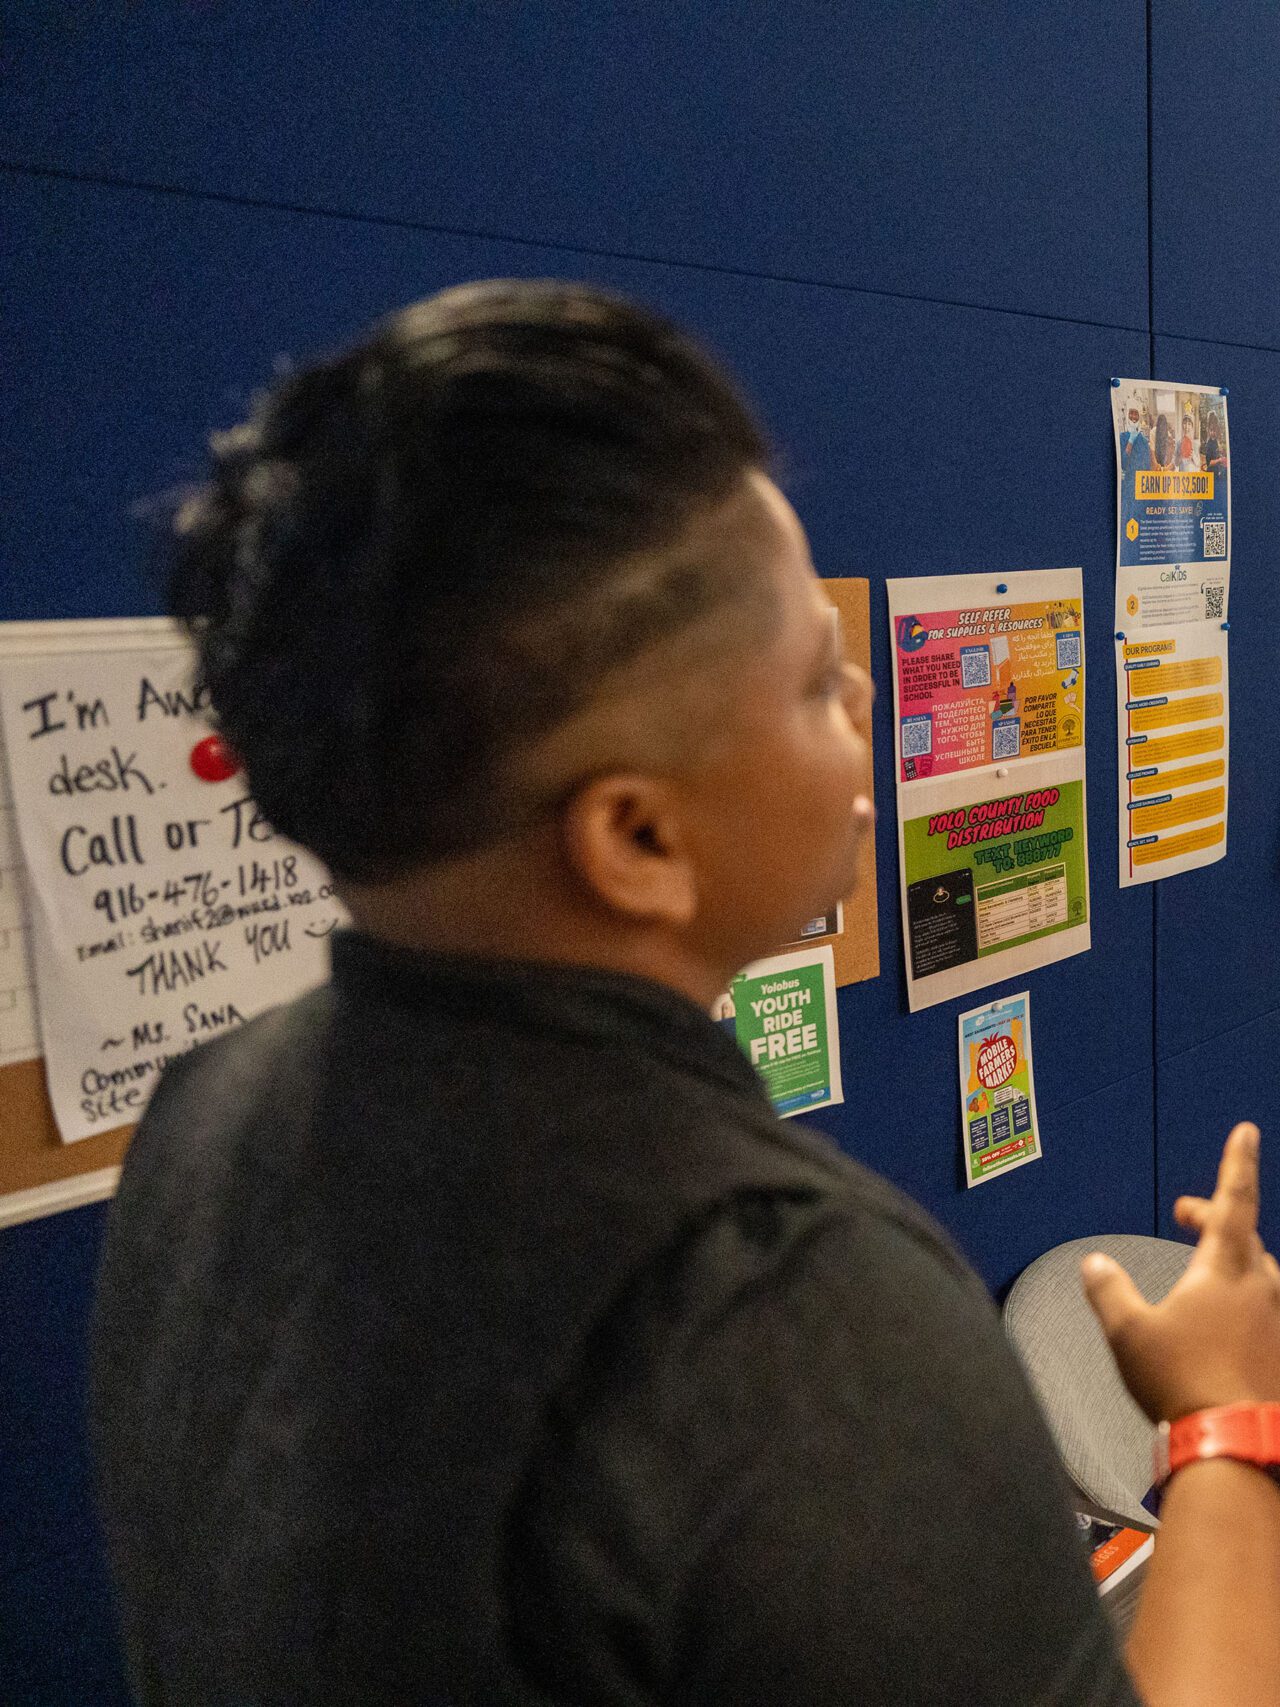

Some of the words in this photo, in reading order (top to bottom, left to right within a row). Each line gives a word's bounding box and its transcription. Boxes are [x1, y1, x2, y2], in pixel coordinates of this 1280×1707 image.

[1141, 475, 1160, 494] EARN
[1162, 475, 1171, 494] UP
[1173, 476, 1181, 494] TO
[1182, 476, 1209, 495] $2,500!
[1130, 524, 1135, 534] 1
[1160, 570, 1188, 583] CalKIDS
[1130, 600, 1135, 610] 2
[958, 611, 981, 625] SELF
[983, 608, 1011, 622] REFER
[927, 628, 945, 640] FOR
[946, 624, 986, 639] SUPPLIES
[989, 622, 996, 634] &
[997, 617, 1044, 632] RESOURCES
[1125, 645, 1140, 656] OUR
[1140, 642, 1173, 655] PROGRAMS
[902, 656, 929, 666] PLEASE
[931, 652, 955, 662] SHARE
[902, 667, 924, 676] WHAT
[926, 663, 941, 672] YOU
[942, 661, 961, 670] NEED
[903, 676, 911, 685] IN
[912, 672, 937, 683] ORDER
[939, 670, 948, 679] TO
[949, 669, 959, 678] BE
[903, 681, 951, 693] SUCCESSFUL
[952, 678, 960, 686] IN
[903, 691, 934, 702] SCHOOL
[1024, 696, 1037, 704] POR
[1037, 693, 1057, 702] FAVOR
[937, 706, 986, 720] ПОДЕЛИТЕСЬ
[1024, 701, 1056, 712] COMPARTE
[1036, 711, 1044, 719] LO
[1044, 708, 1057, 717] QUE
[23, 690, 109, 741] I'm
[953, 716, 968, 724] ЧТО
[970, 713, 986, 722] ВАМ
[1024, 717, 1057, 729] NECESITAS
[941, 725, 969, 735] НУЖНО
[970, 721, 985, 730] ДЛЯ
[960, 729, 985, 740] ЧТОБЫ
[1021, 729, 1038, 738] PARA
[1038, 725, 1057, 735] TENER
[966, 738, 985, 748] БЫТЬ
[1040, 734, 1049, 742] EN
[1049, 732, 1057, 740] LA
[1030, 740, 1057, 752] ESCUELA
[935, 747, 980, 761] УСПЕШНЫМ
[958, 754, 985, 765] ШКОЛЕ
[49, 745, 168, 797] desk.
[928, 809, 965, 836] YOLO
[968, 795, 1024, 824] COUNTY
[1024, 788, 1060, 811] FOOD
[60, 814, 146, 876] Call
[165, 816, 209, 852] or
[220, 796, 274, 850] Te
[947, 809, 1045, 850] DISTRIBUTION
[974, 843, 1011, 865] TEXT
[1013, 827, 1074, 855] KEYWORD
[93, 855, 299, 926] 916-476-1418
[126, 938, 229, 997] THANK
[244, 918, 293, 965] YOU
[760, 979, 800, 995] Yolobus
[750, 988, 811, 1017] YOUTH
[763, 1009, 803, 1034] RIDE
[750, 1023, 818, 1066] FREE
[980, 1038, 1009, 1067] MOBILE
[978, 1044, 1016, 1080] FARMERS
[985, 1057, 1015, 1087] MARKET
